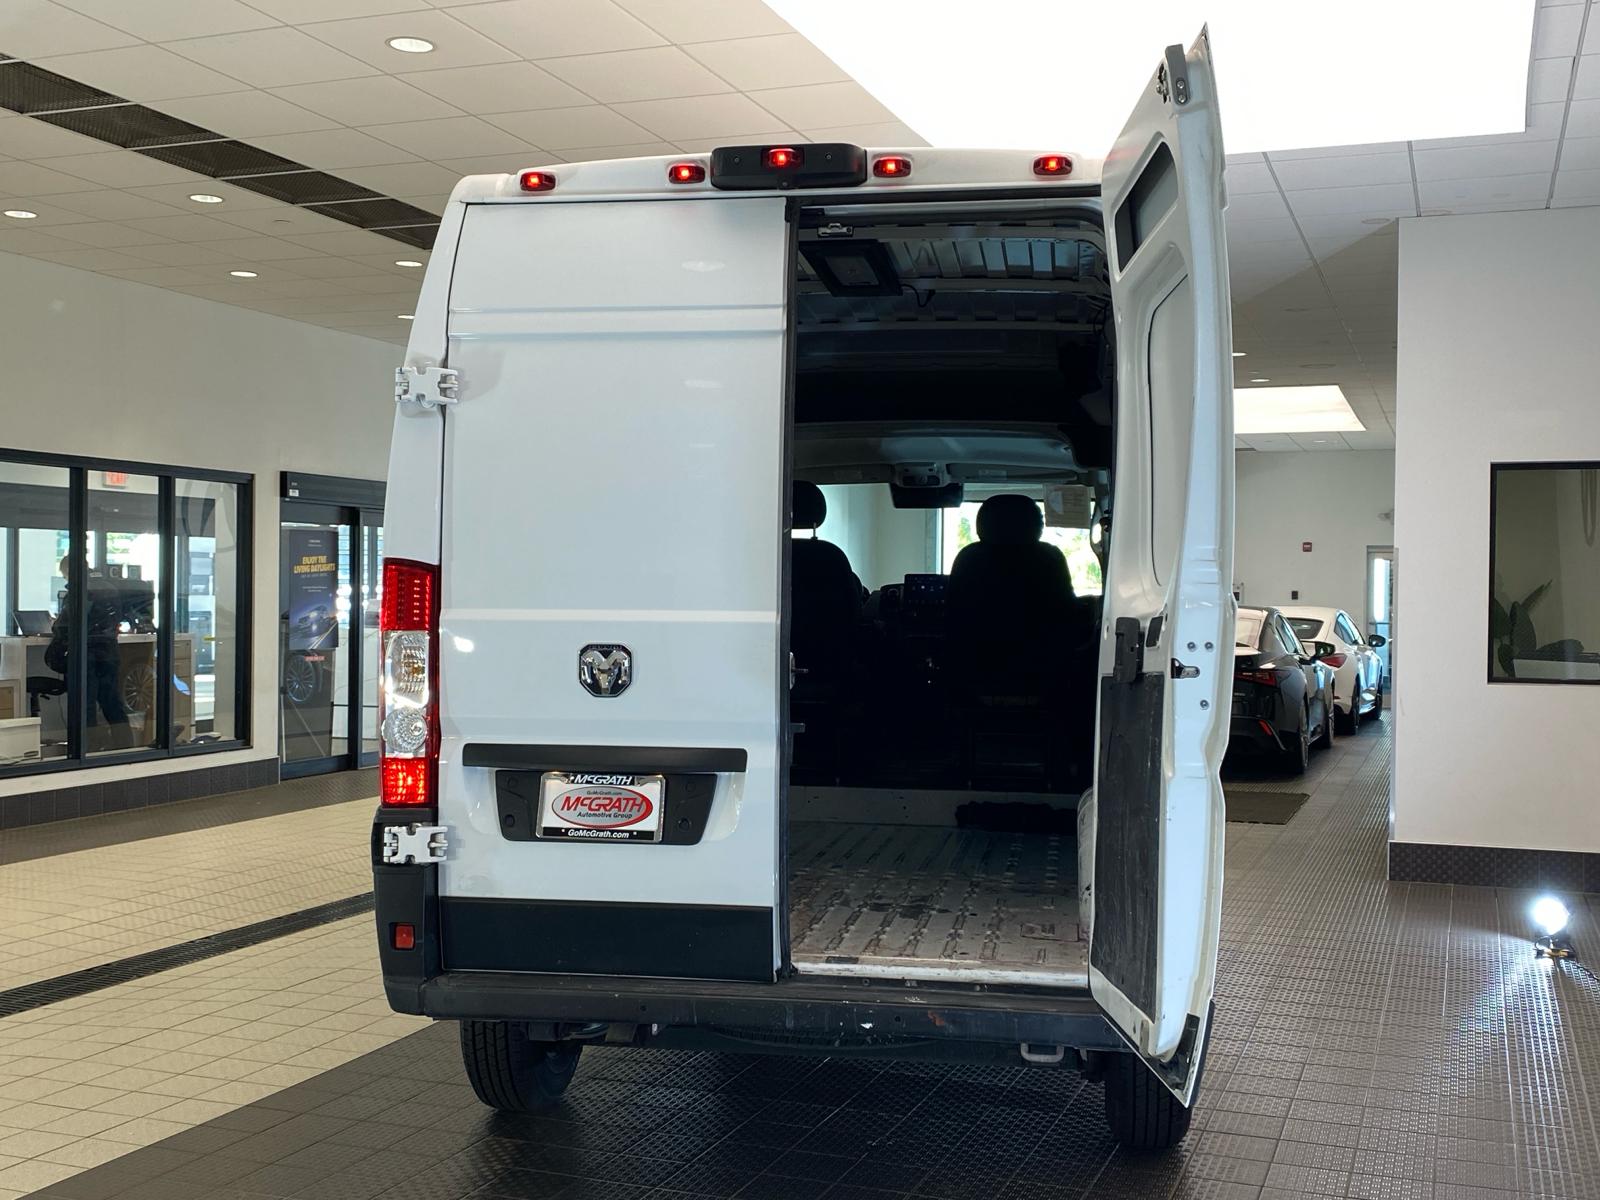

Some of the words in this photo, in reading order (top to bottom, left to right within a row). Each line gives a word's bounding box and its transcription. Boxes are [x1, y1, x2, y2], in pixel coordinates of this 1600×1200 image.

[302, 556, 318, 564] ENJOY
[318, 555, 327, 564] THE
[294, 565, 311, 573] LIVING
[311, 563, 336, 572] DAYLIGHTS
[577, 811, 612, 819] Automotive
[568, 829, 629, 839] GoMcGrath.com
